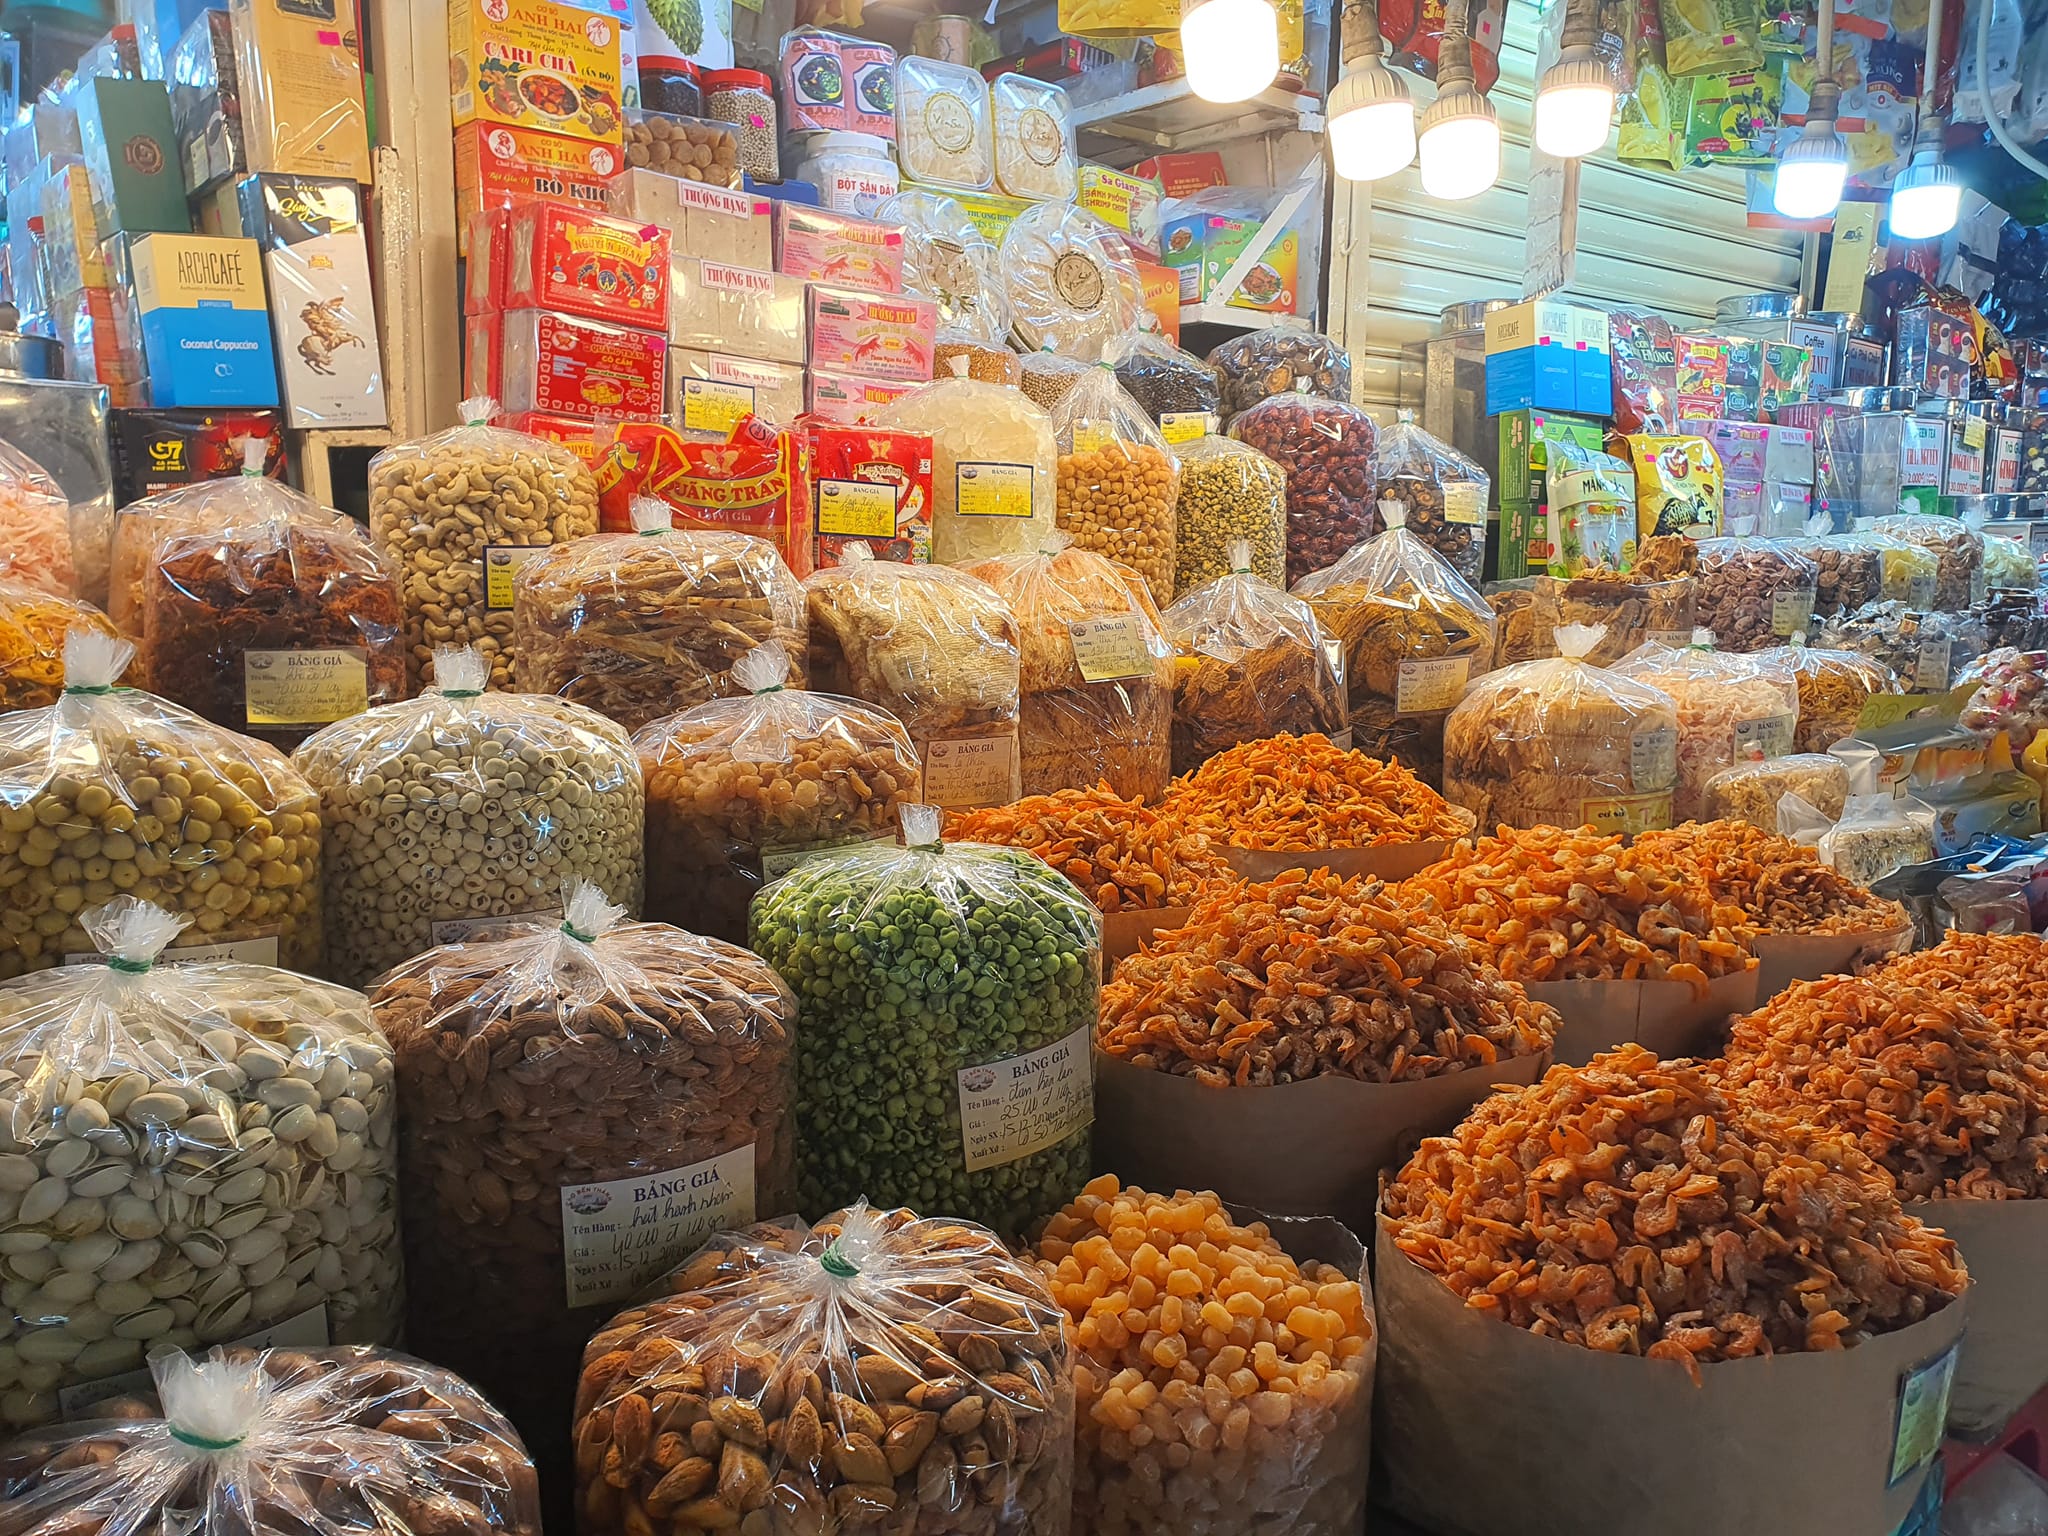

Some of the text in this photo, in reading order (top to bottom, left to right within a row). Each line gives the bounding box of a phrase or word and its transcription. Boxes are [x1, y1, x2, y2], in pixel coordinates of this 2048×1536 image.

[513, 9, 548, 26] ANH
[555, 18, 582, 34] HAI
[485, 42, 577, 74] CARI CHÀ
[518, 144, 586, 164] ANH HAI
[535, 177, 563, 196] BÒ
[837, 177, 857, 191] BỘT
[1101, 174, 1140, 196] Sa Giang
[684, 188, 747, 214] THƯỢNG HẠNG
[178, 250, 245, 286] ARCHCAFÉ
[707, 268, 770, 292] THƯỢNG HẠNG
[180, 338, 259, 352] Coconut Cappuccino
[1804, 334, 1825, 348] Coffee
[149, 440, 184, 461] G7
[869, 487, 880, 495] GIÁ
[1094, 621, 1127, 633] BẢNG GIÁ
[288, 654, 342, 666] BẢNG GIÁ
[1424, 664, 1444, 672] BẢNG
[958, 742, 994, 754] BẢNG GIÁ
[1012, 1043, 1070, 1079] BẢNG GIÁ
[967, 1098, 1001, 1111] Tên Hàng
[969, 1120, 982, 1129] Giá
[970, 1130, 998, 1145] Ngày SX
[971, 1147, 988, 1160] Xuất
[633, 1164, 721, 1203] BẢNG GIÁ
[572, 1223, 616, 1235] Tên Hàng
[574, 1248, 588, 1258] Giá
[575, 1263, 613, 1276] Ngày SX
[575, 1281, 599, 1293] Xuất
